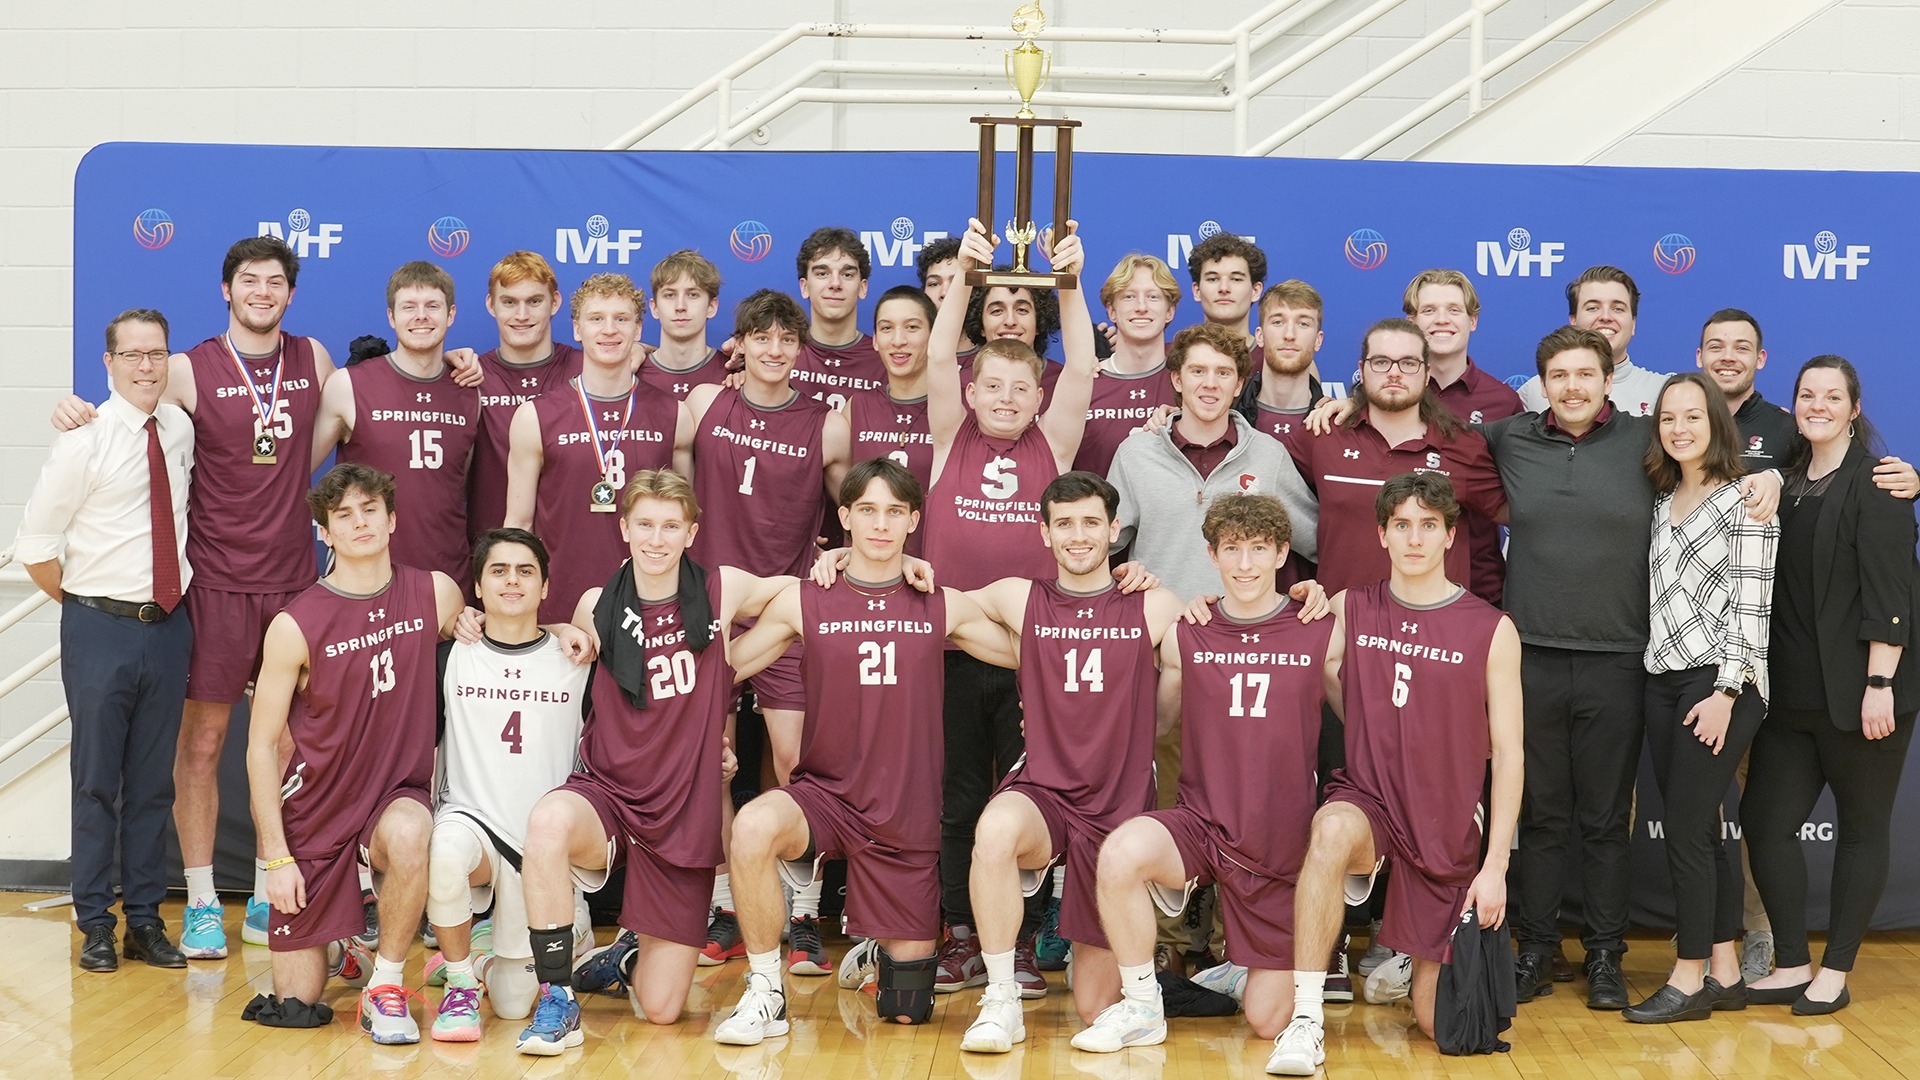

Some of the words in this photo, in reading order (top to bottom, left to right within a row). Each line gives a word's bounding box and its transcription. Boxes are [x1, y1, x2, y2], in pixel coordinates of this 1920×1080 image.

[556, 228, 642, 264] IVHF
[1476, 241, 1565, 277] IVHF
[1783, 244, 1871, 280] IVHF
[216, 378, 310, 398] SPRNGIELD
[789, 368, 882, 390] PRINGFIELD
[252, 398, 294, 439] 25
[371, 409, 467, 427] SPRINGFIELD
[408, 429, 444, 470] 15
[557, 429, 664, 446] SPRNGFIELD
[711, 425, 808, 458] SPRINGFIELD
[858, 430, 934, 445] SPRINGFIE
[604, 449, 626, 490] 8
[738, 456, 757, 496] 1
[980, 455, 1019, 500] S
[954, 495, 1042, 512] SPRINGFIELD
[957, 508, 1038, 523] VOLLEYBALL
[325, 618, 424, 658] SPRINGFELD
[818, 620, 933, 635] SPRINGFIELD
[858, 641, 898, 685] 21
[1193, 651, 1312, 667] SPRINGFIELD
[1356, 634, 1464, 664] SPRNGFIELD
[369, 647, 396, 698] 13
[647, 649, 696, 700] 20
[1064, 648, 1104, 692] 14
[1391, 662, 1413, 708] 6
[456, 685, 570, 703] SPRINGFIELD
[1229, 672, 1271, 718] 17
[500, 710, 523, 754] 4
